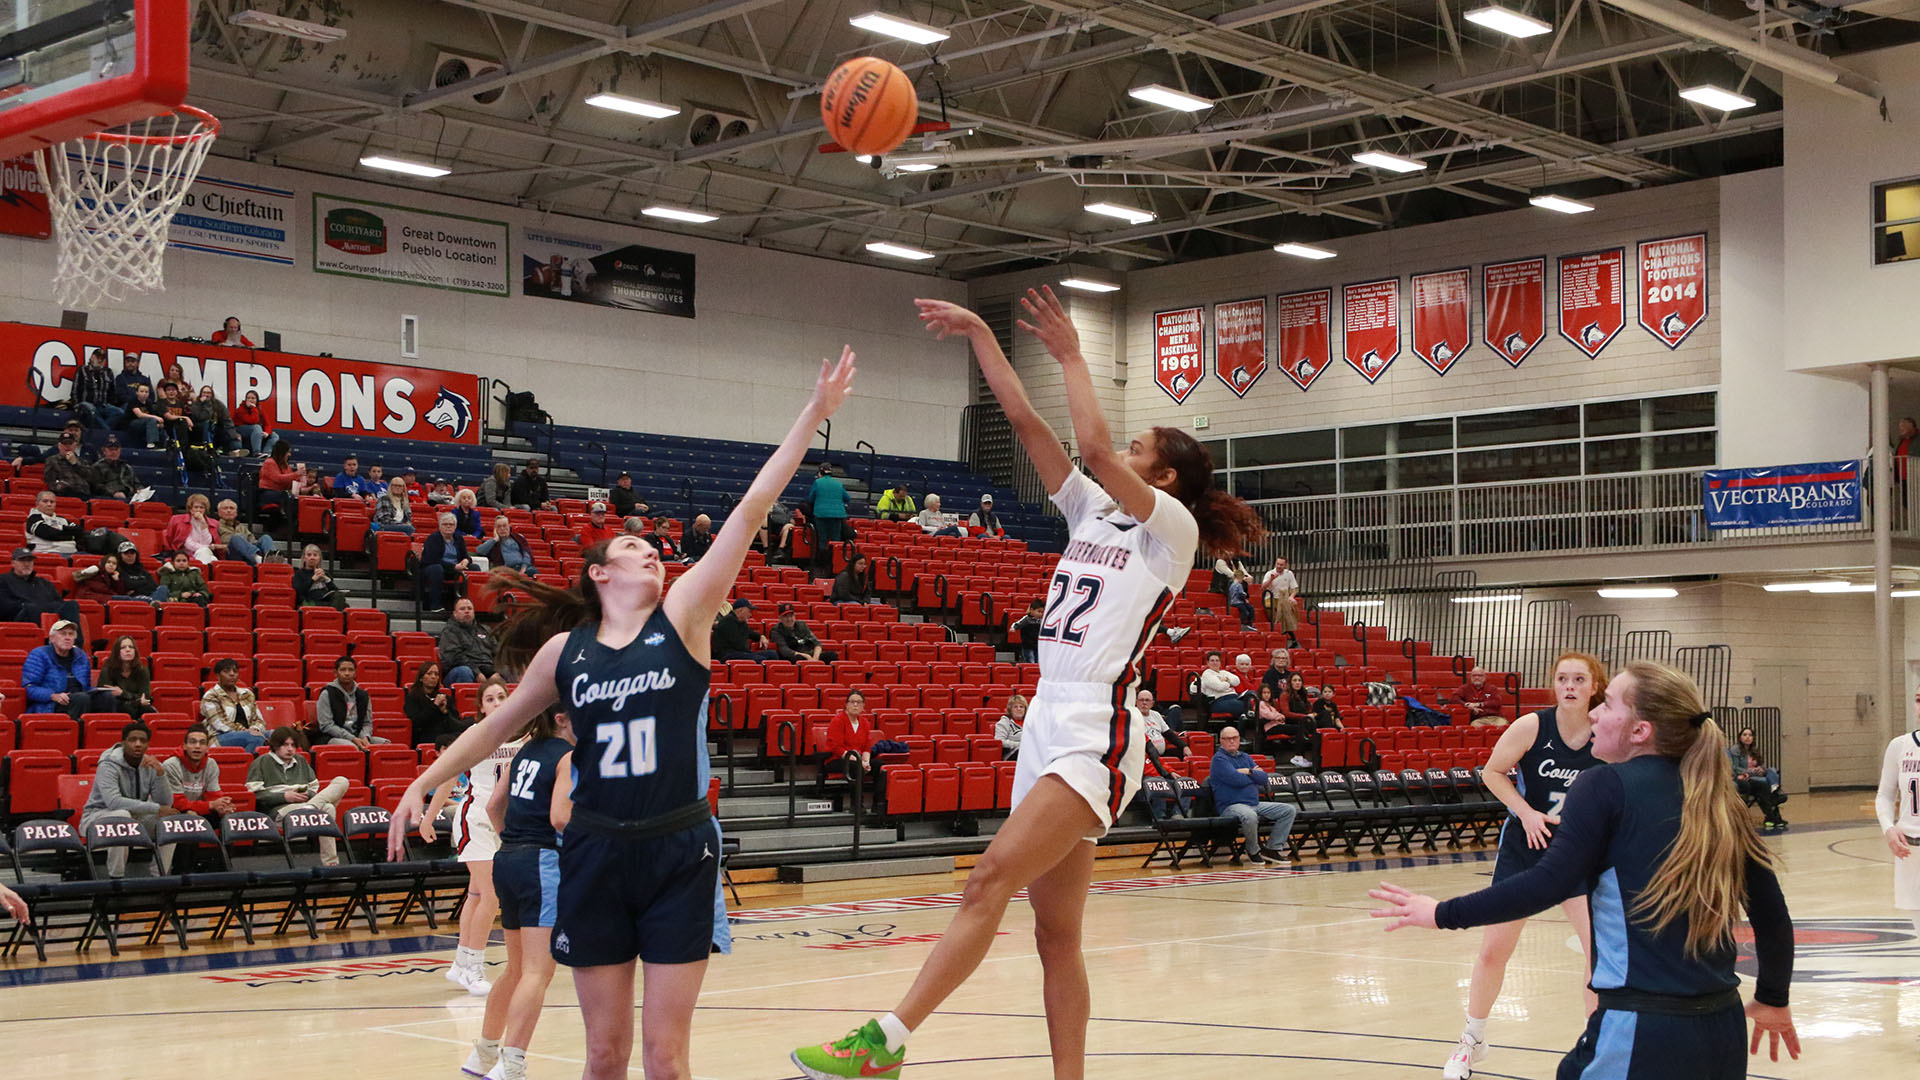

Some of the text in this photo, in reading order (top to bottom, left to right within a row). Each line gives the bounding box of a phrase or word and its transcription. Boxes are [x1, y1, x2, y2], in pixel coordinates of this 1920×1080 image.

[202, 192, 284, 222] Chieftain
[329, 222, 383, 239] COURTYARD
[402, 226, 497, 250] Great Downtown
[402, 242, 497, 266] Pueblo Location!
[1649, 242, 1696, 258] NATIONAL
[1644, 253, 1701, 270] CHAMPIONS
[1648, 265, 1697, 282] FOOTBALL
[471, 280, 505, 292] 542-3200
[1648, 282, 1697, 304] 2014
[612, 286, 684, 304] THUNDERWOLVES
[1162, 310, 1198, 326] NATIONAL
[1158, 322, 1200, 336] CHAMPIONS
[1169, 334, 1189, 345] MEN'S
[1161, 344, 1198, 356] BASKETBALL
[1161, 354, 1198, 371] 1961
[1806, 499, 1852, 509] COLORADO
[1039, 569, 1104, 647] 22
[572, 668, 676, 712] Cougars
[596, 716, 657, 779] 20
[510, 759, 541, 800] 32
[1297, 775, 1318, 785] PACK
[1324, 774, 1345, 784] PACK
[1351, 774, 1372, 783] PACK
[1378, 773, 1398, 782] PACK
[1404, 772, 1423, 781] PACK
[1428, 770, 1448, 779] PACK
[1453, 769, 1472, 778] PACK
[1538, 759, 1579, 787] Coug
[1147, 781, 1170, 791] PACK
[1177, 780, 1200, 790] PACK
[1268, 776, 1289, 786] PACK
[228, 817, 269, 832] PACK
[290, 813, 330, 827] PACK
[350, 811, 389, 824] PACK
[23, 824, 71, 839] PACK
[95, 823, 141, 838] PACK
[163, 819, 207, 833] PACK
